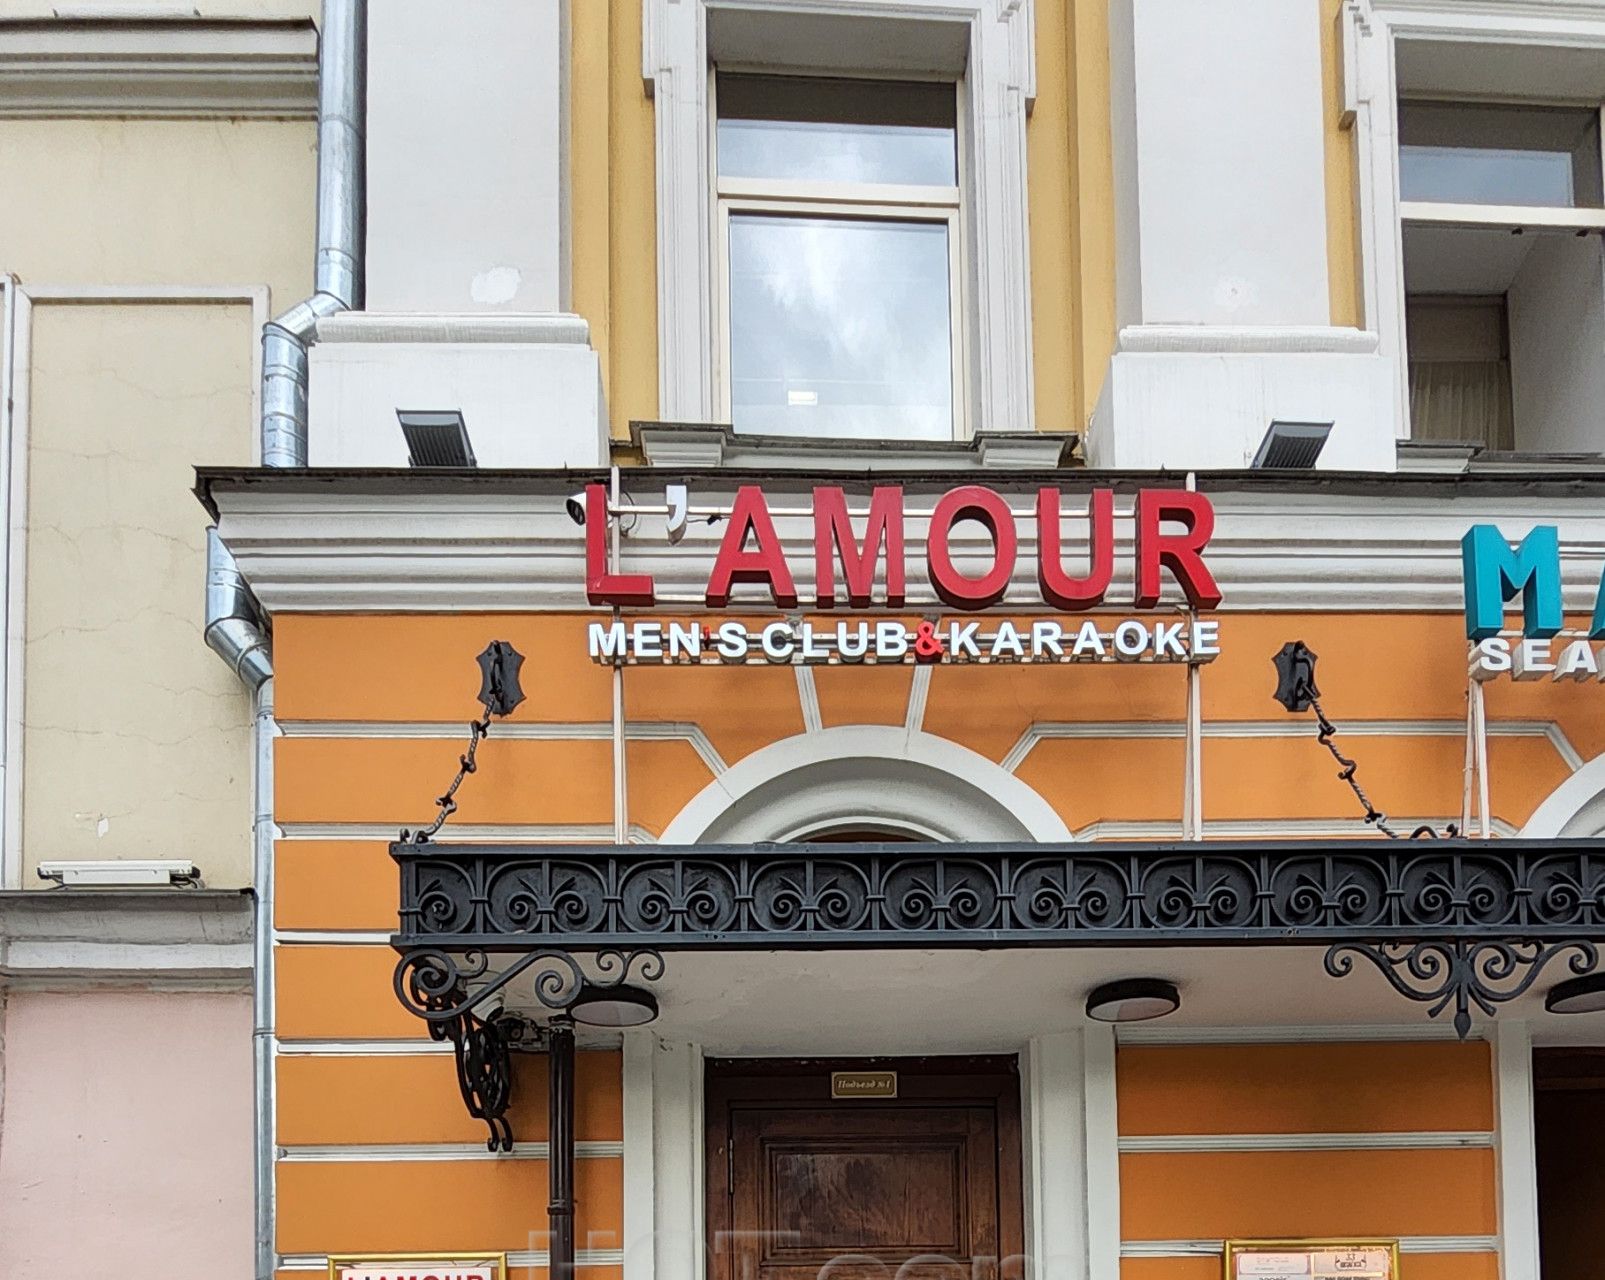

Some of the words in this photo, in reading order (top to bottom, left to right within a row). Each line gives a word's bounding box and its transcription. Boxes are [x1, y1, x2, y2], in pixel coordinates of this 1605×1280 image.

[585, 484, 1223, 609] L'AMOUR
[1462, 524, 1605, 640] M
[1469, 637, 1605, 681] SEA
